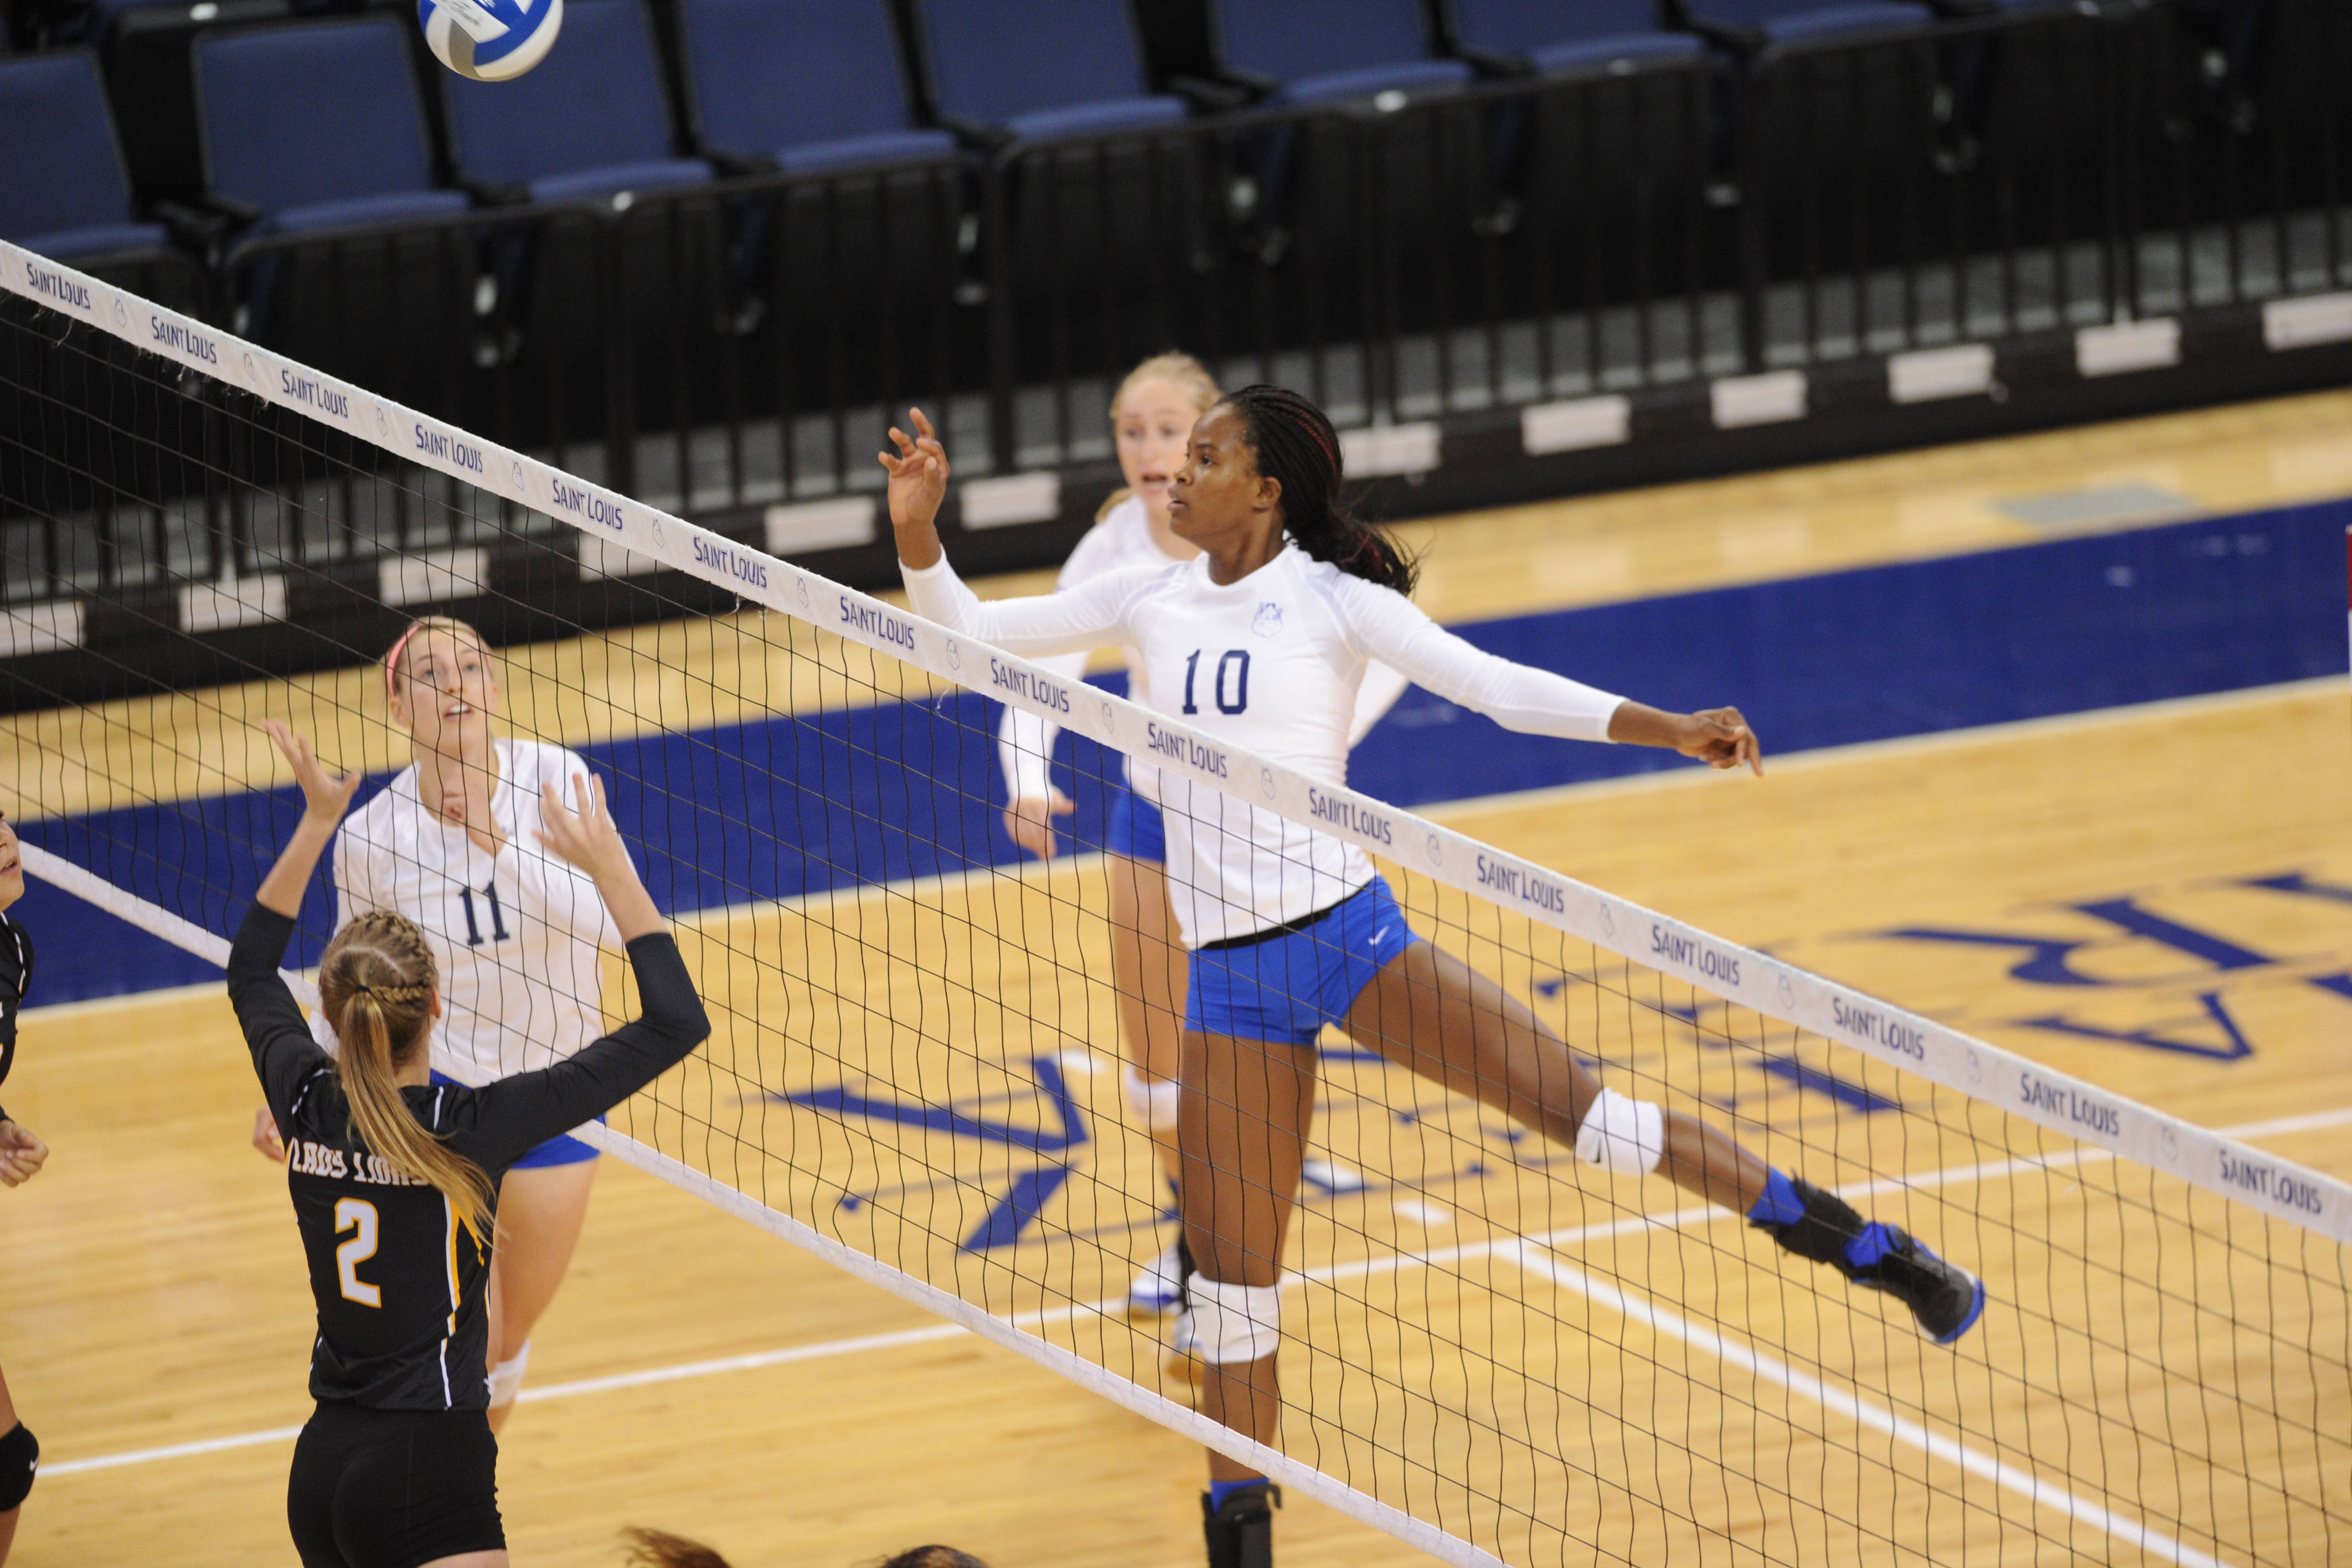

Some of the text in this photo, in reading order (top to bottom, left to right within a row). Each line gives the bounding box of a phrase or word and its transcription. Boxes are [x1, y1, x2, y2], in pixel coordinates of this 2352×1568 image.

[27, 263, 90, 310] SAINT LOUIS
[152, 316, 216, 364] SAINT LOUIS
[282, 370, 348, 418] SAINT LOUIS
[416, 424, 482, 473] SAINT LOUIS
[553, 479, 622, 530] SAINT LOUIS
[693, 537, 767, 589] SAINT LOUIS
[840, 596, 914, 649] SANT LOUIS
[991, 658, 1069, 713] SAINT LOUIS
[1182, 648, 1251, 715] 10
[1148, 722, 1227, 778] SAINT LOUIS
[1309, 787, 1391, 845] SAINT LOUIS
[1477, 854, 1564, 913] SAINT LOUIS
[458, 881, 510, 945] 11
[1652, 924, 1739, 986] SAINT LOUIS
[1833, 997, 1924, 1061] SAINT LOUIS
[2021, 1072, 2118, 1136] SAINT LOUIS
[292, 1137, 348, 1179] LADY
[2220, 1149, 2321, 1214] SAINT LOUIS
[335, 1196, 381, 1308] 2
